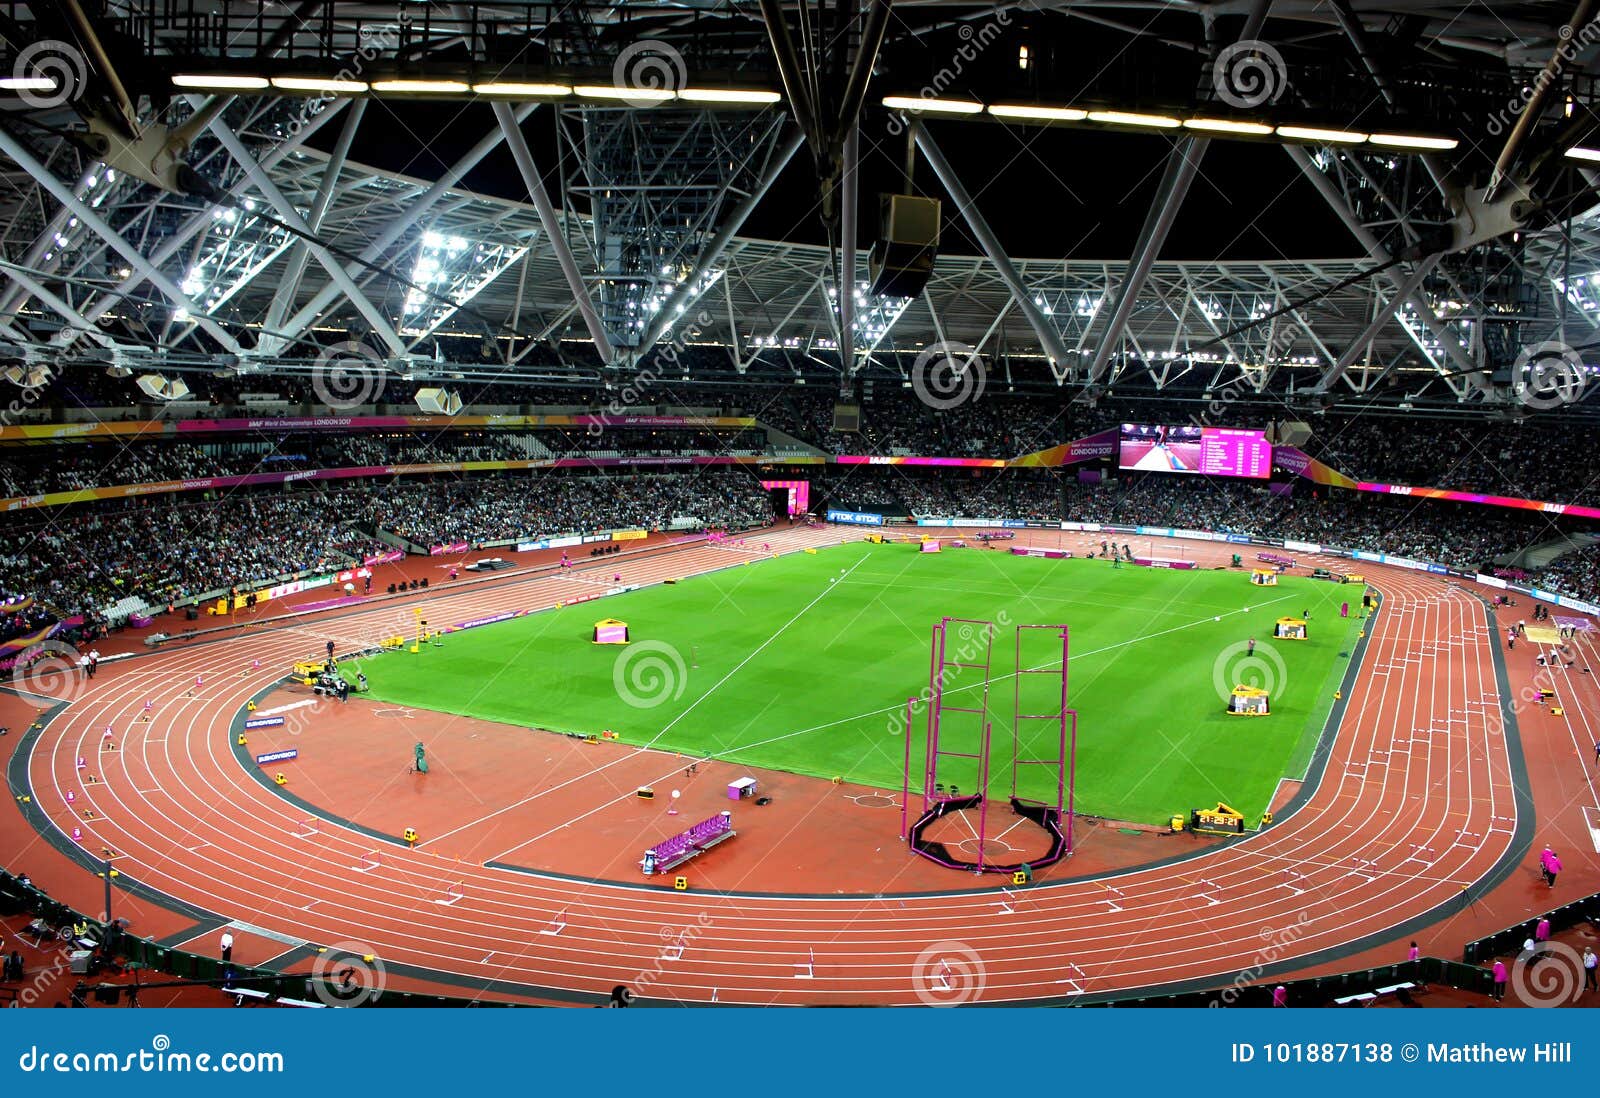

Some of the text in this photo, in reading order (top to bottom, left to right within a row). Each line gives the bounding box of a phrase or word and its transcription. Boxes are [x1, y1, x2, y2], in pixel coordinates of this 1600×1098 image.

[1071, 447, 1113, 456] LONDON 2017
[180, 481, 200, 489] LONDON
[1390, 485, 1412, 494] IAAF
[1544, 502, 1565, 513] IAAF
[860, 515, 879, 523] TDK
